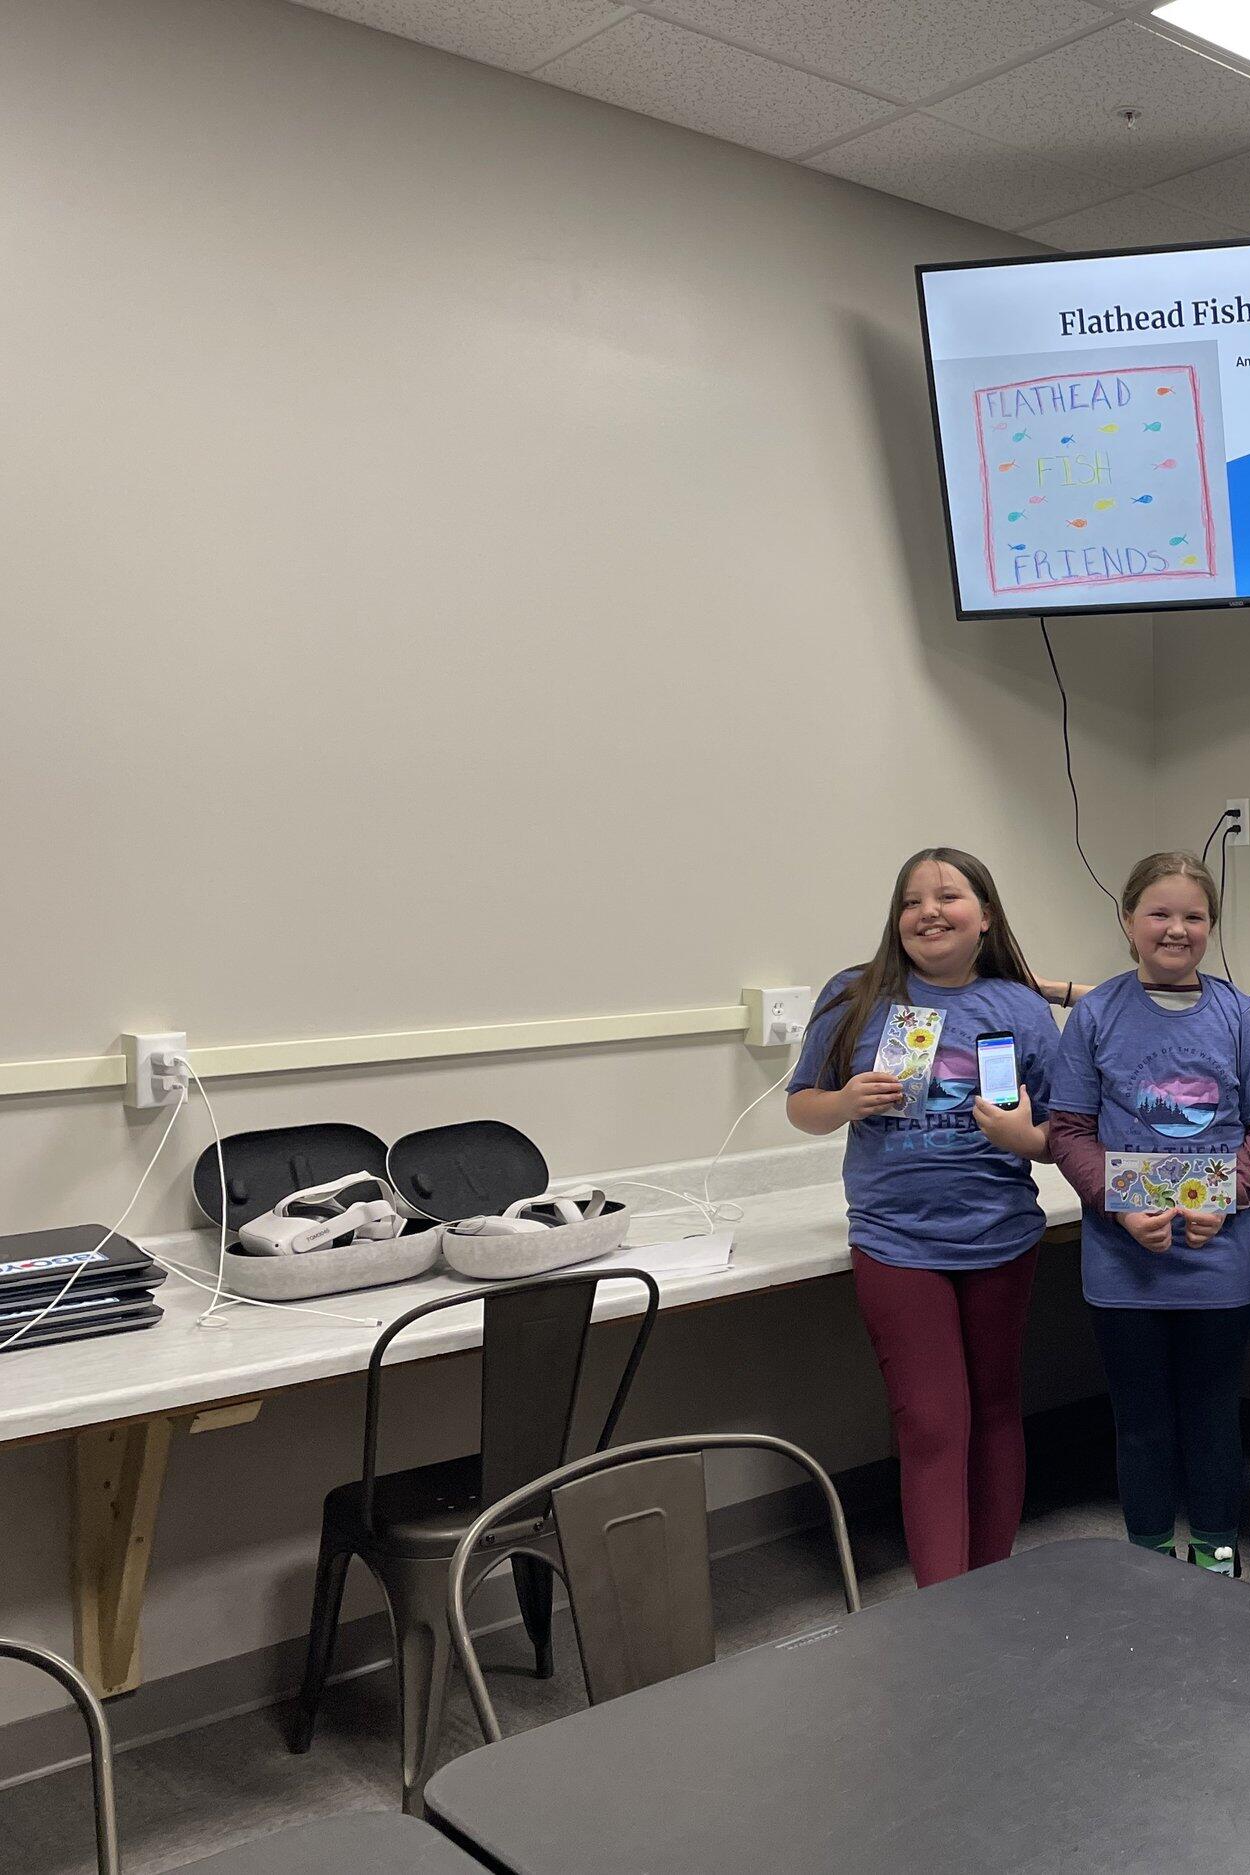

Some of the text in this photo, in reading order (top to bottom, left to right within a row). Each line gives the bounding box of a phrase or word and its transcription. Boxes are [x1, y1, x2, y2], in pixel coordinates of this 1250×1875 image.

[1059, 300, 1185, 336] Flathead
[986, 377, 1131, 418] FLATHEAD
[1036, 450, 1112, 488] FISH
[1013, 547, 1170, 585] FRIENDS
[1162, 1046, 1174, 1054] OF
[1178, 1046, 1196, 1055] THE
[885, 1113, 981, 1132] FLATHEA
